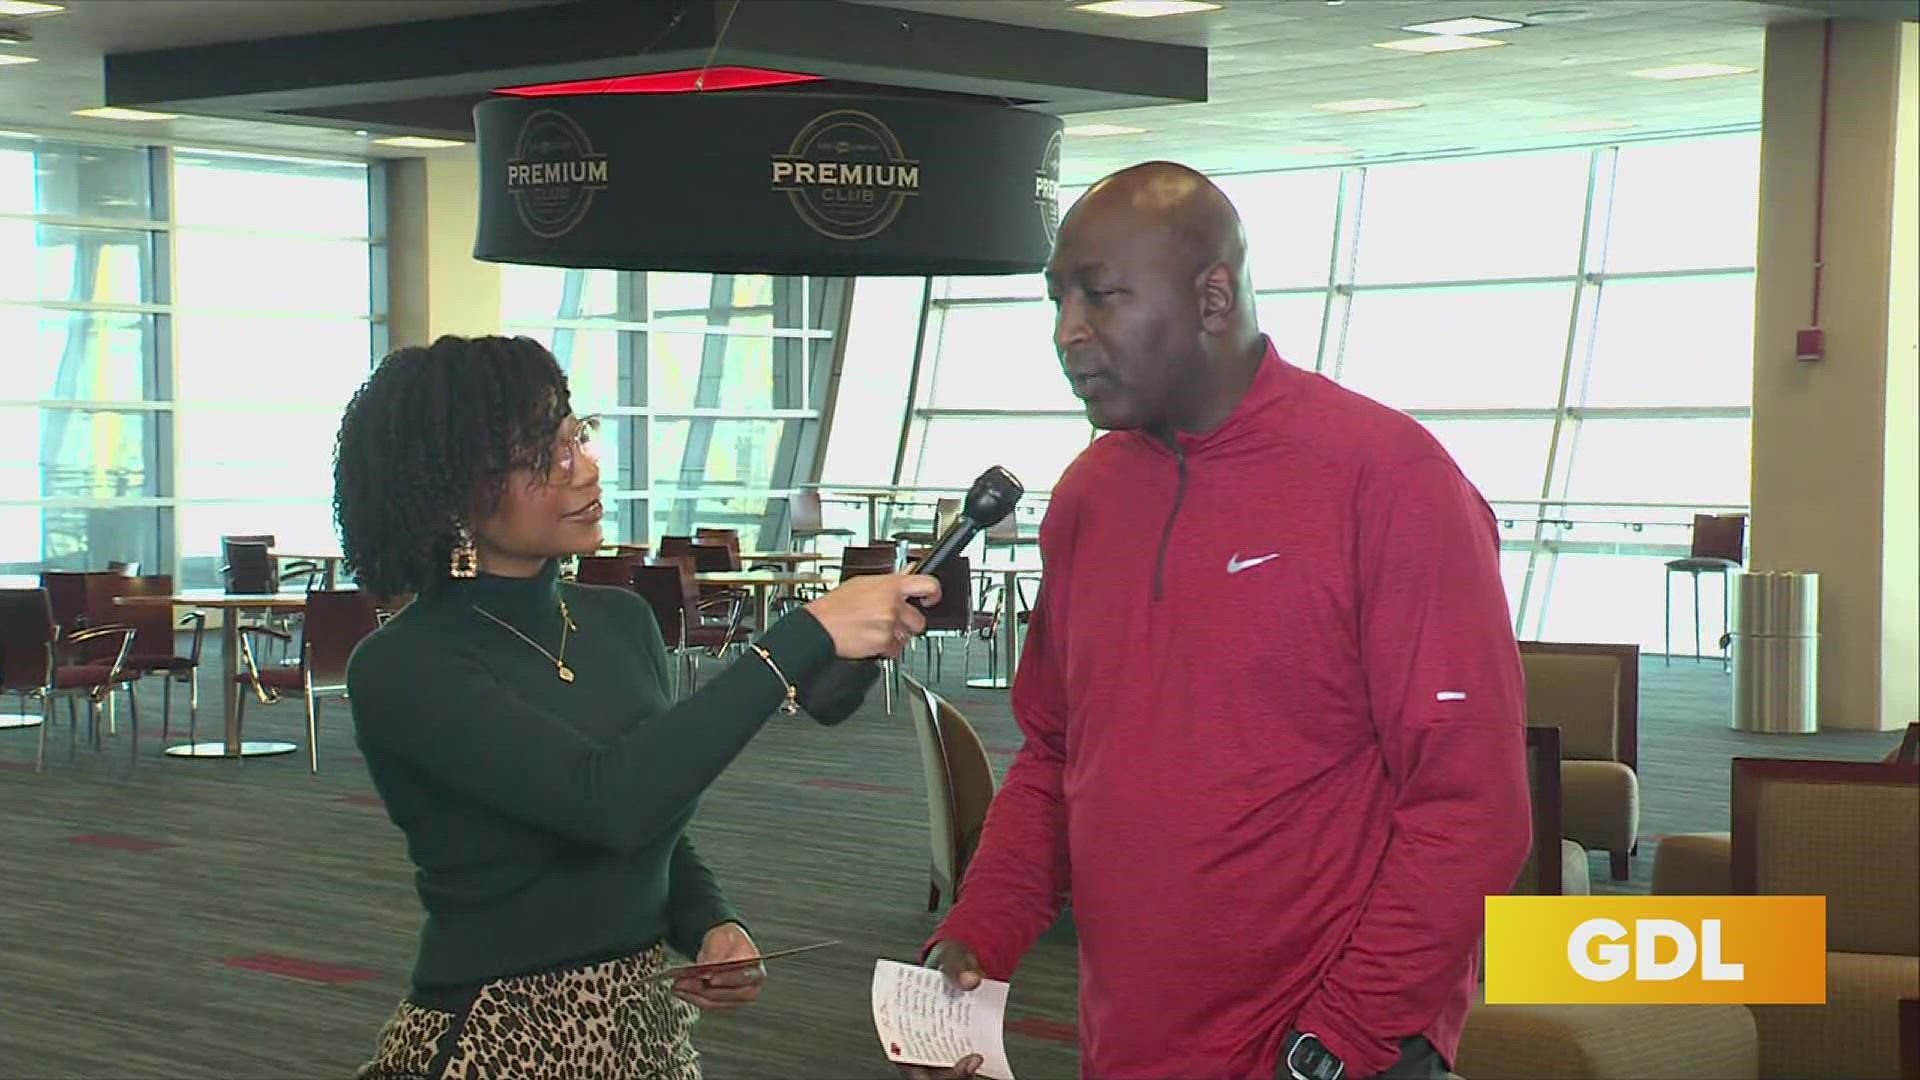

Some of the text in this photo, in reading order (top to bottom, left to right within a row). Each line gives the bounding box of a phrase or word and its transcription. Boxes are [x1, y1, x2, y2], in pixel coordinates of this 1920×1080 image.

[507, 161, 608, 186] PREMIUM
[772, 161, 920, 188] PREMIUM
[822, 188, 874, 202] CLUB
